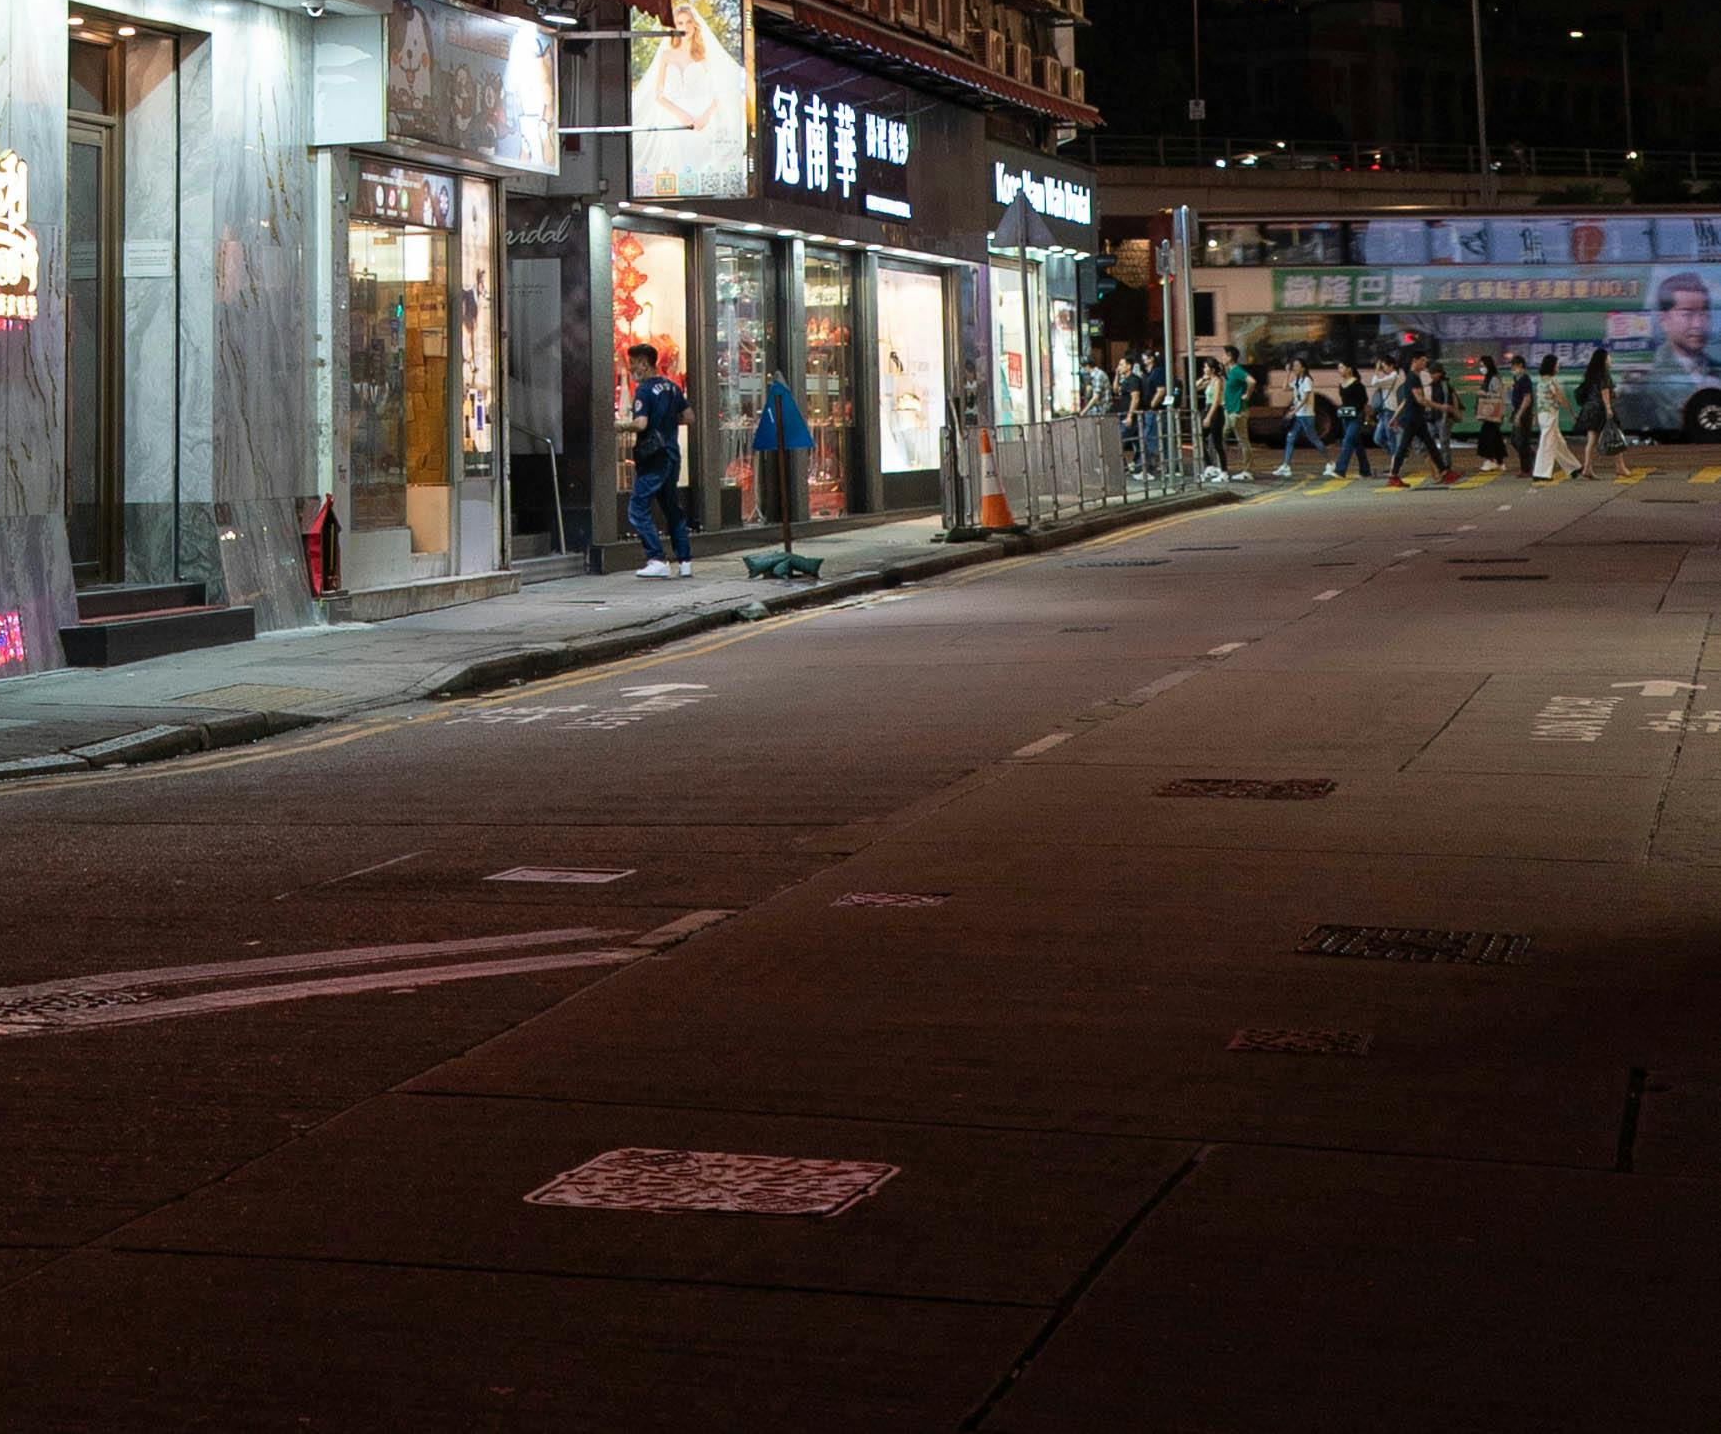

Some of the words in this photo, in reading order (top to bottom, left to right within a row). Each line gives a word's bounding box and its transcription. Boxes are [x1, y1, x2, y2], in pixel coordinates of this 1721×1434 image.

[773, 84, 857, 198] 冠南華
[504, 214, 572, 245] ridal
